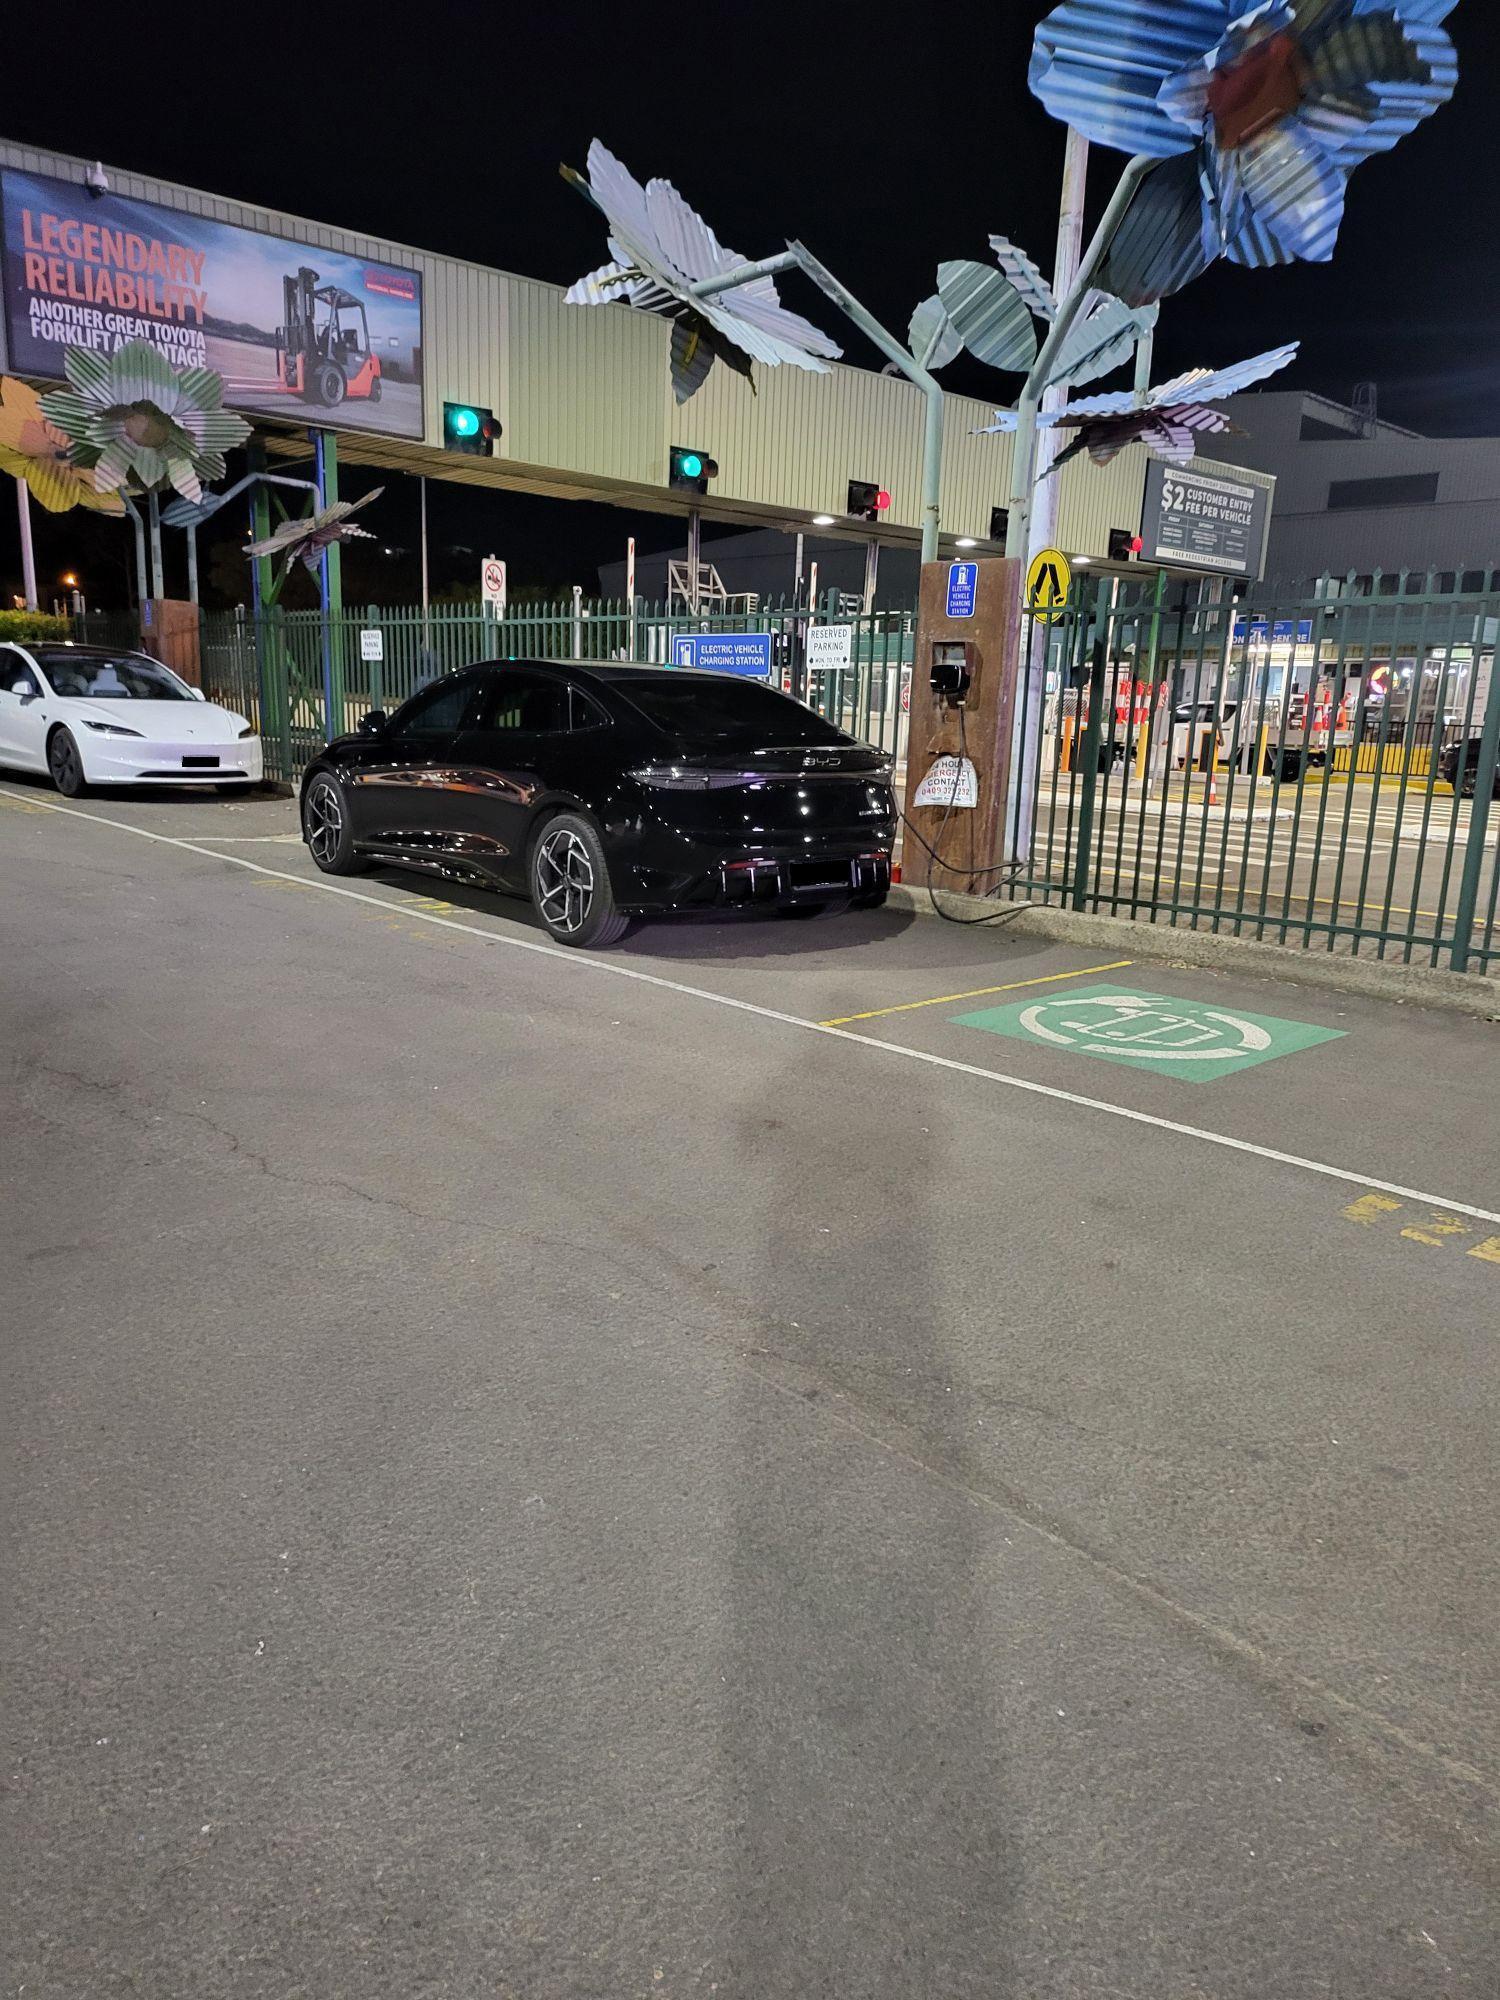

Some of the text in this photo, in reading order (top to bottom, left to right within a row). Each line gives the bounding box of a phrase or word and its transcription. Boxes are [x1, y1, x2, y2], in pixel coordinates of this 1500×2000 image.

[22, 208, 206, 285] LEGENDARY
[24, 251, 208, 325] RELIABILITY
[29, 297, 206, 350] ANOTHER GREAT TOYOTA
[31, 317, 207, 369] FORKLIFT ANTAGE
[1161, 480, 1185, 512] $2
[1186, 488, 1253, 513] CUSTOMER ENTRY
[1185, 501, 1252, 525] FEE PER VEHICLE
[811, 628, 848, 639] RESERVED
[701, 644, 764, 654] ELECTRIC VEHICLE
[813, 641, 844, 651] PARKING
[699, 656, 765, 666] CHARGING STATION
[802, 757, 841, 766] BYD
[921, 787, 942, 796] 0409
[927, 779, 966, 787] CONTACT
